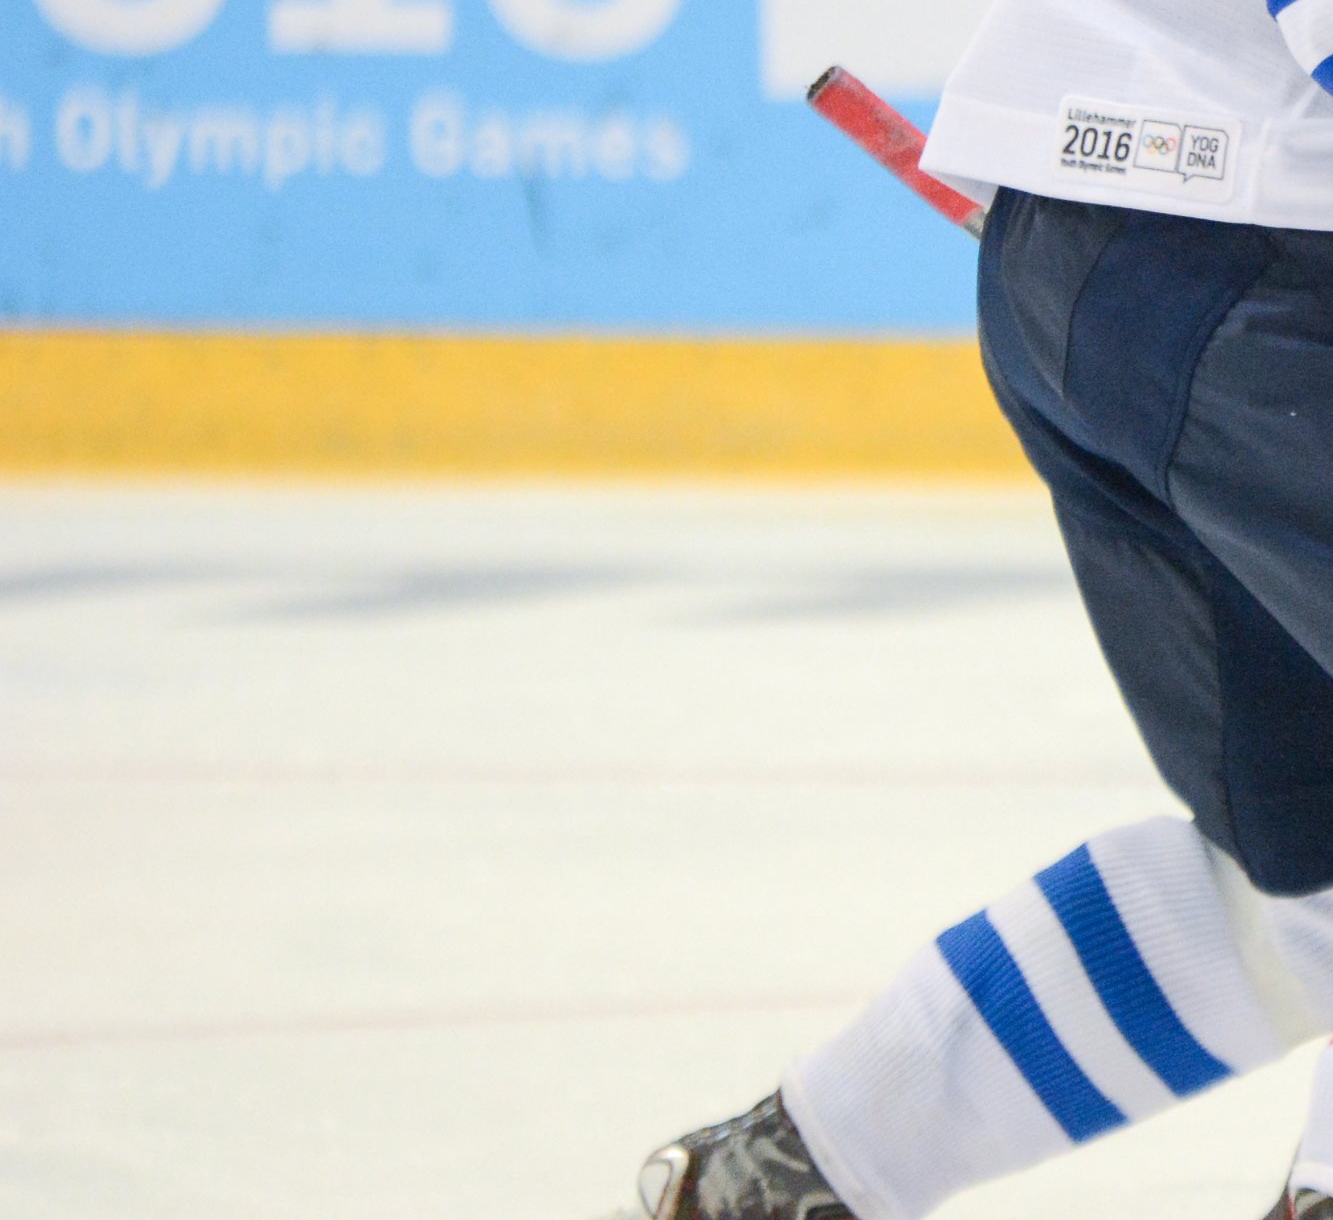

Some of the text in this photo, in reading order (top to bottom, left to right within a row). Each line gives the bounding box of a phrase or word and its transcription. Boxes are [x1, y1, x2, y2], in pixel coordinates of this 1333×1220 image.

[1067, 107, 1137, 129] Lillehammer
[55, 85, 385, 191] Olympic
[409, 87, 690, 180] Games
[1062, 124, 1133, 162] 2016
[1190, 135, 1219, 153] YOG
[1186, 151, 1217, 169] DNA
